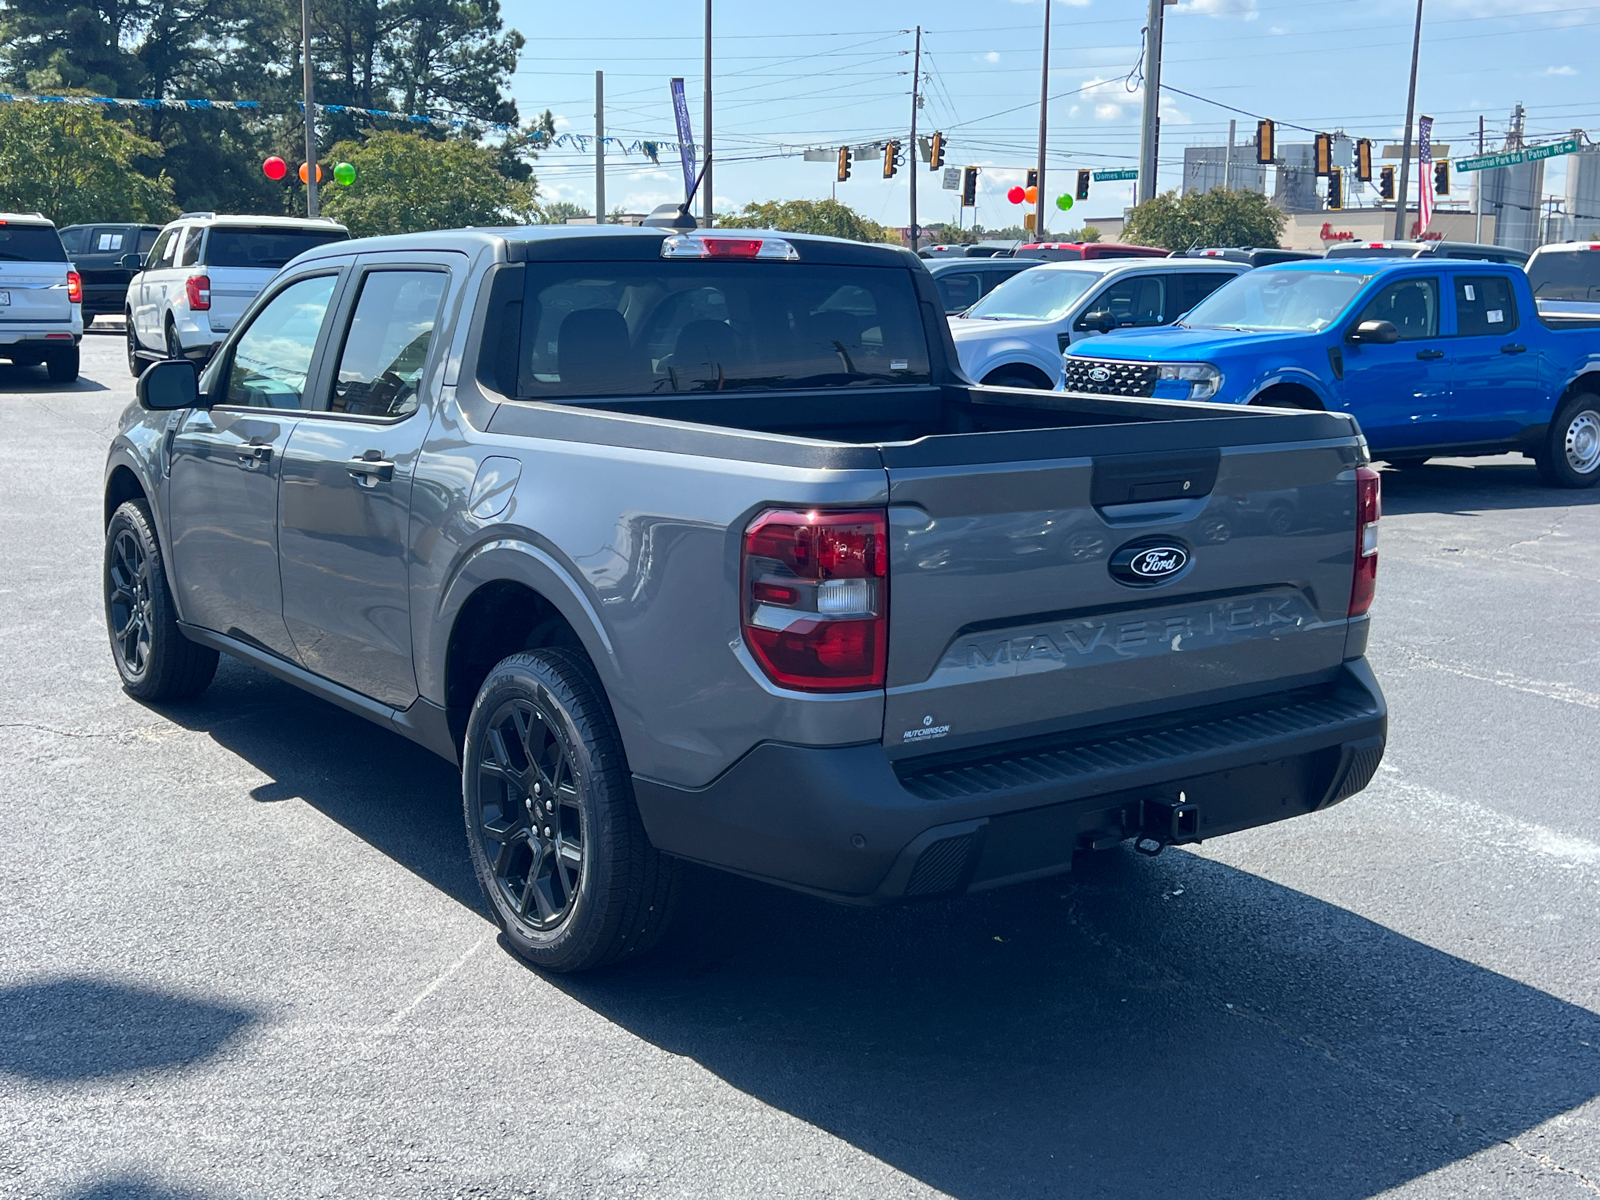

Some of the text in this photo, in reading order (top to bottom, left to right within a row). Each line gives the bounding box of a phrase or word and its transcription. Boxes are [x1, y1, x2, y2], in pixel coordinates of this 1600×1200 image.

[1528, 145, 1564, 159] Patrol Rd
[1467, 154, 1521, 170] Industrial Park Rd
[1095, 172, 1118, 180] Dames
[1142, 552, 1177, 572] Ford
[966, 600, 1299, 669] MAVERICK
[903, 725, 950, 738] HUTCHINSON
